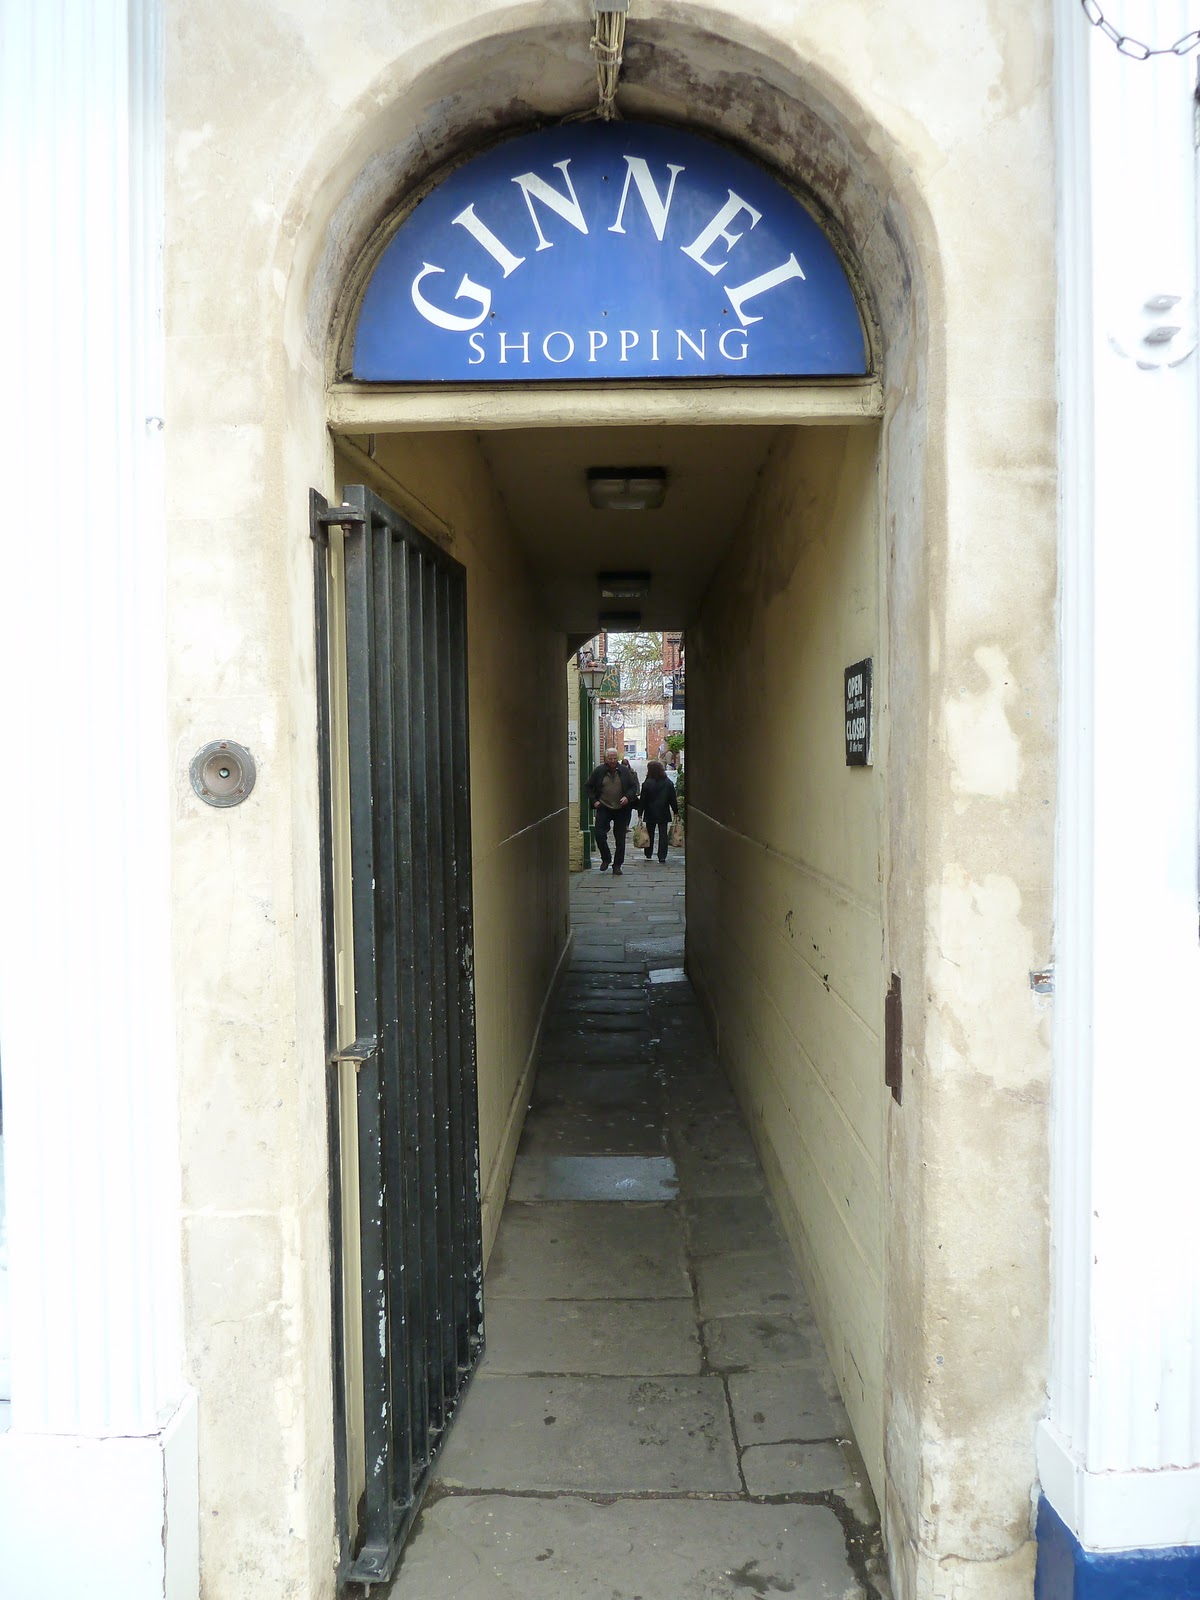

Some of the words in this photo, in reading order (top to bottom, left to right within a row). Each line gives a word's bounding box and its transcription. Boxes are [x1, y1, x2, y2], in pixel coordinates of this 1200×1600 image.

[411, 154, 806, 332] GINNEL
[467, 328, 750, 365] SHOPPING
[847, 673, 863, 699] OPEN
[846, 717, 866, 741] CLOSED
